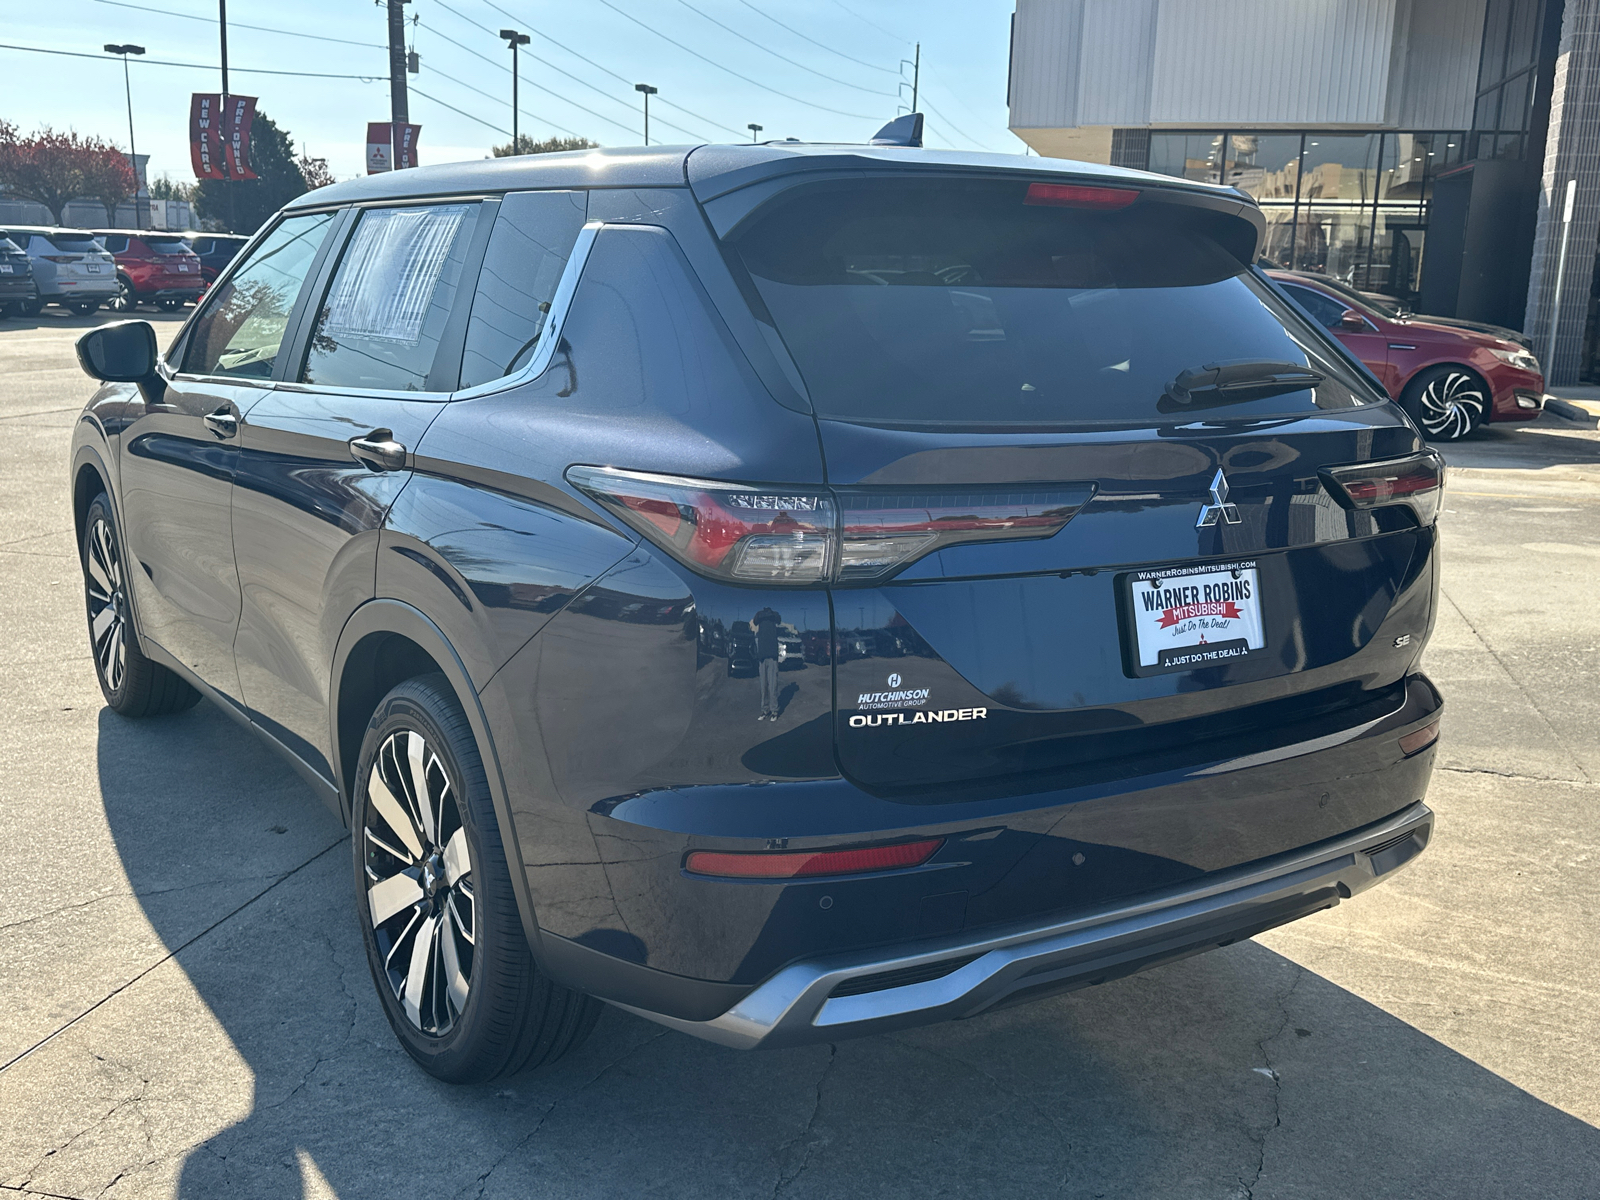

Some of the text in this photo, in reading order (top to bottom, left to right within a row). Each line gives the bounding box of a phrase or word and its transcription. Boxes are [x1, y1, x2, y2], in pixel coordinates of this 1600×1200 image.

[199, 99, 211, 173] NEW CARS
[232, 101, 246, 174] PRE-OWNED
[1141, 579, 1251, 612] WARNER ROBINS
[1172, 603, 1226, 620] MITSUBISHI
[1172, 618, 1231, 637] Just Do The Deal!
[1394, 634, 1410, 649] SE
[1172, 648, 1240, 666] JUST DO THE DEAL!
[858, 689, 930, 704] HUTCHINSON
[858, 699, 926, 711] AUTOMOTIVE GROUP
[849, 707, 987, 728] OUTLANDER
